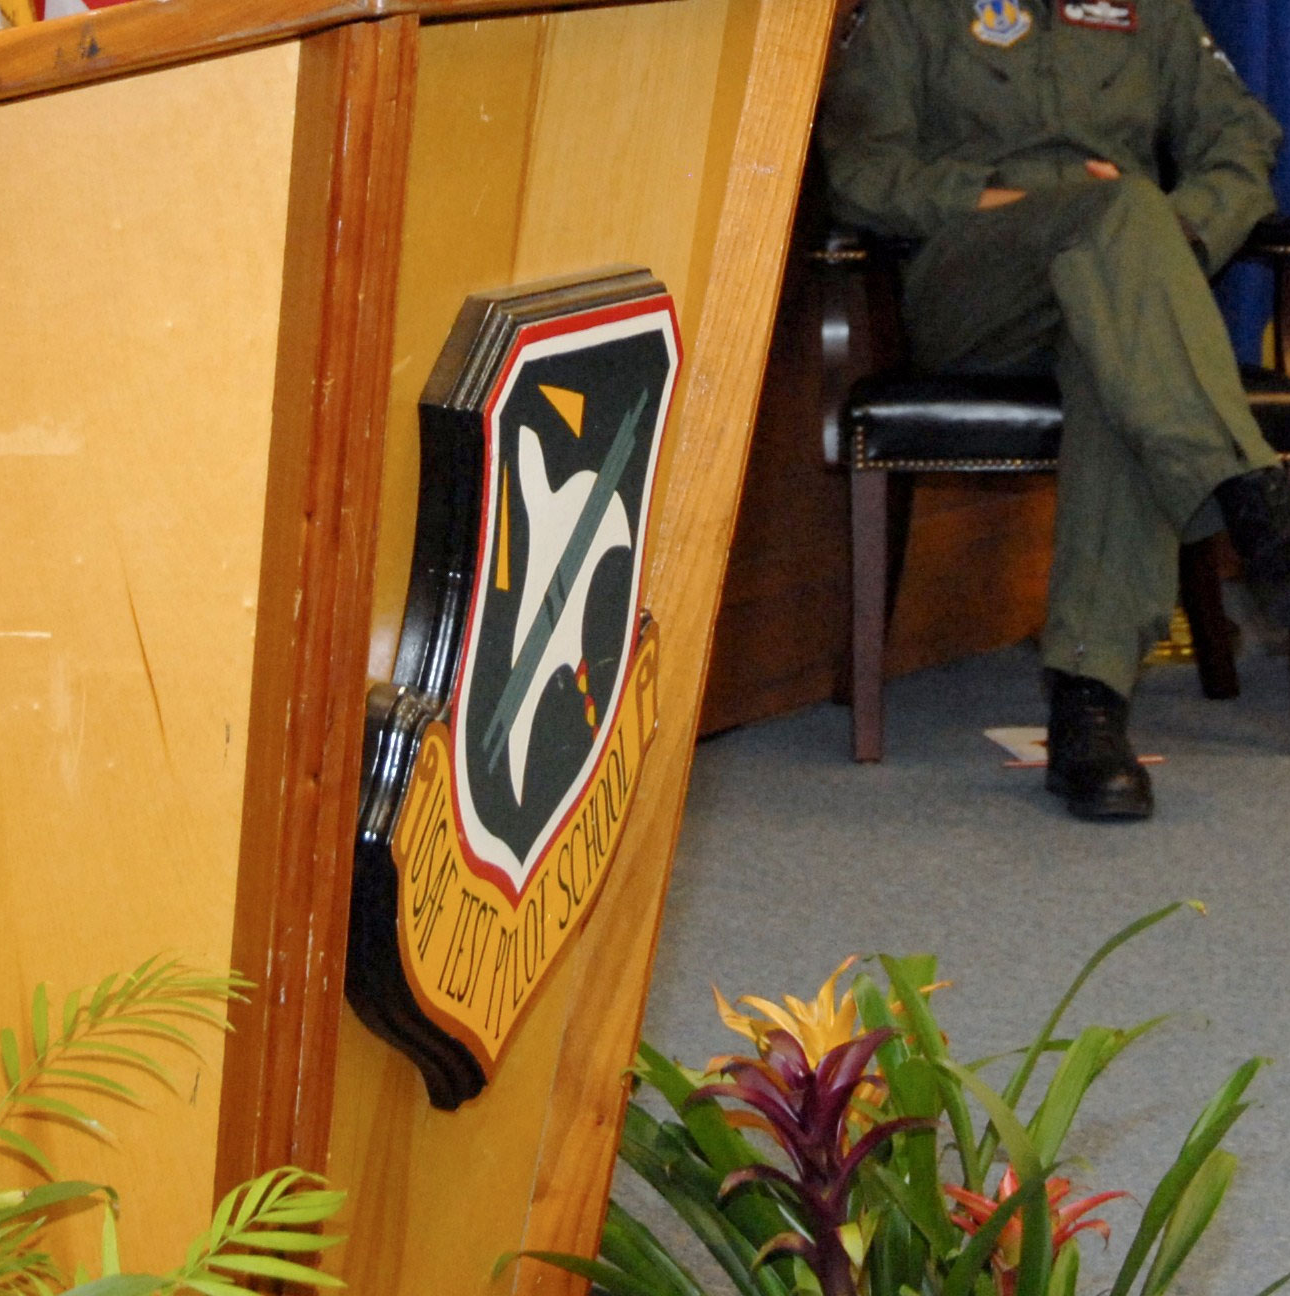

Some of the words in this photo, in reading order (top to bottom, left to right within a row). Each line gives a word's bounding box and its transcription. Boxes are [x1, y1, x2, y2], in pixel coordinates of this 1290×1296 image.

[410, 777, 458, 962] USAF
[437, 886, 499, 1009] TEST
[484, 869, 550, 1041] PILOT
[557, 725, 634, 931] SCHOOL
